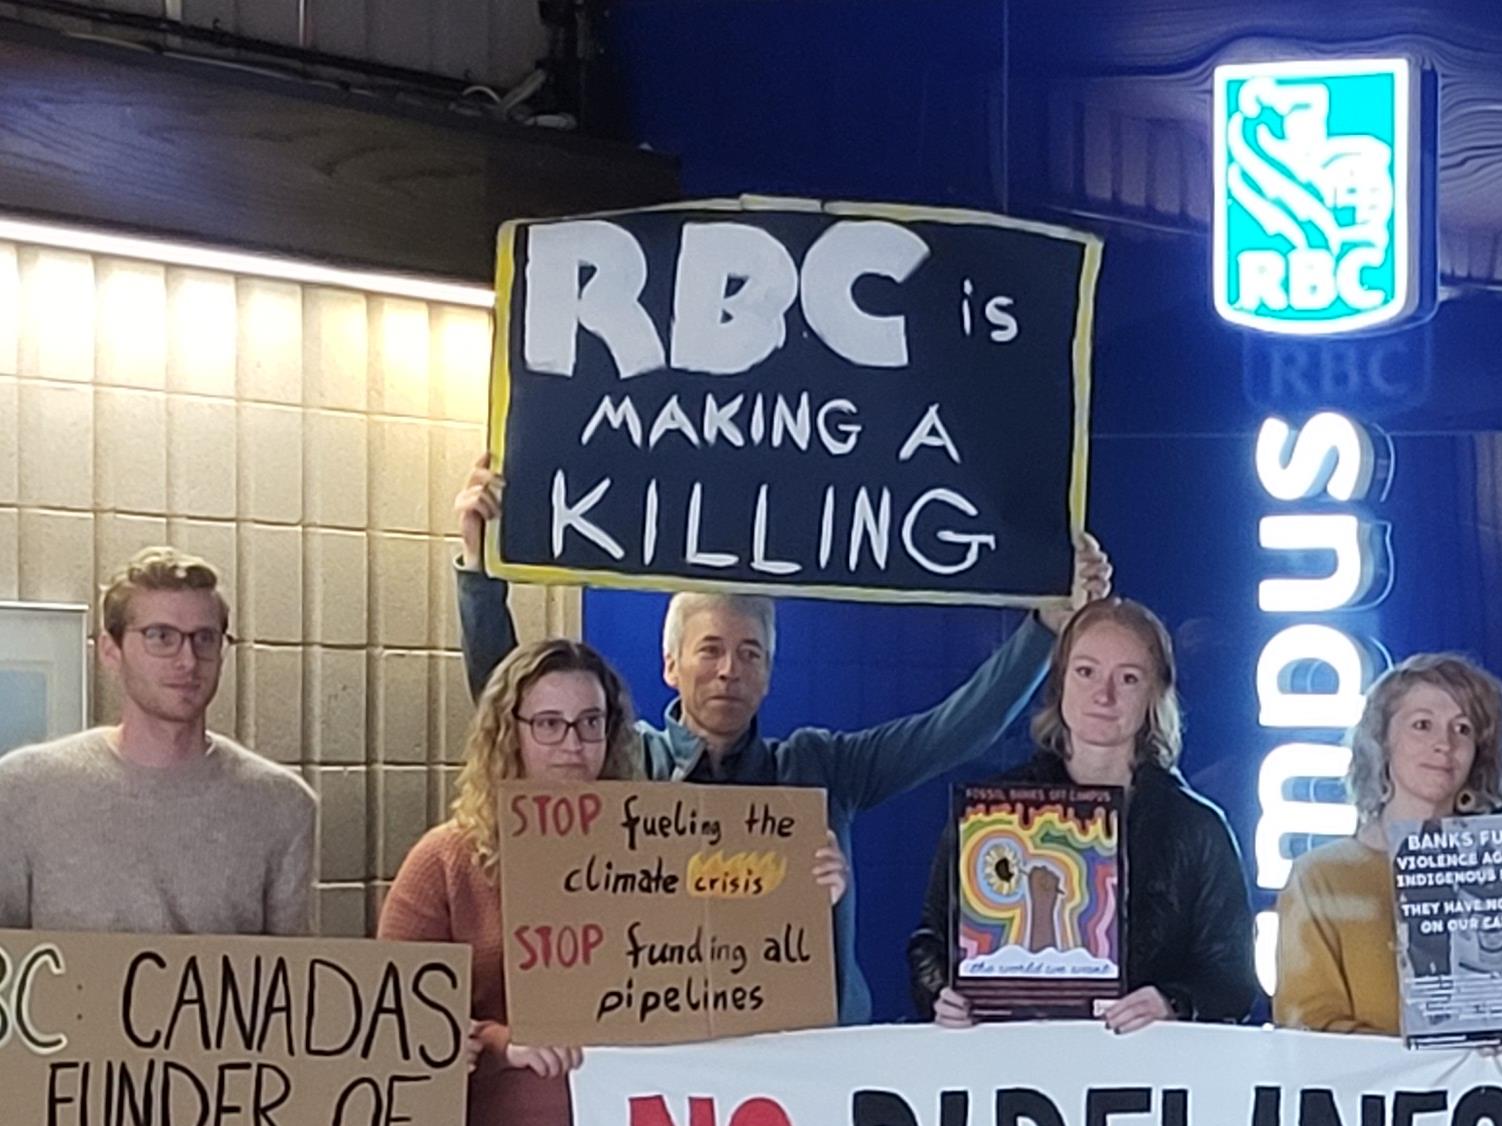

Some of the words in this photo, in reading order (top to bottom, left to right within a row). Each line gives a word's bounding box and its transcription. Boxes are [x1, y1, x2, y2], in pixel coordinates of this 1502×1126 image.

[524, 219, 931, 380] RBC
[961, 277, 1019, 343] is
[1232, 246, 1387, 312] RBC
[580, 391, 863, 455] MAKING
[898, 403, 962, 464] A
[551, 468, 997, 575] KILLING
[510, 793, 603, 838] STOP
[620, 795, 723, 851] fueling
[745, 803, 796, 839] the
[1407, 830, 1474, 851] BANKS
[563, 855, 679, 895] climate
[694, 868, 764, 895] crisis
[1396, 852, 1479, 871] VIOLENCE
[1396, 866, 1497, 888] INDIGENOUS
[1401, 901, 1440, 918] THEY
[1444, 898, 1483, 915] HAVE
[1420, 919, 1444, 935] ON
[1447, 916, 1479, 932] OUR
[512, 923, 605, 971] STOP
[626, 922, 748, 975] funding
[763, 922, 811, 965] all
[121, 951, 462, 1070] CANADAS
[595, 977, 765, 1024] pipelines
